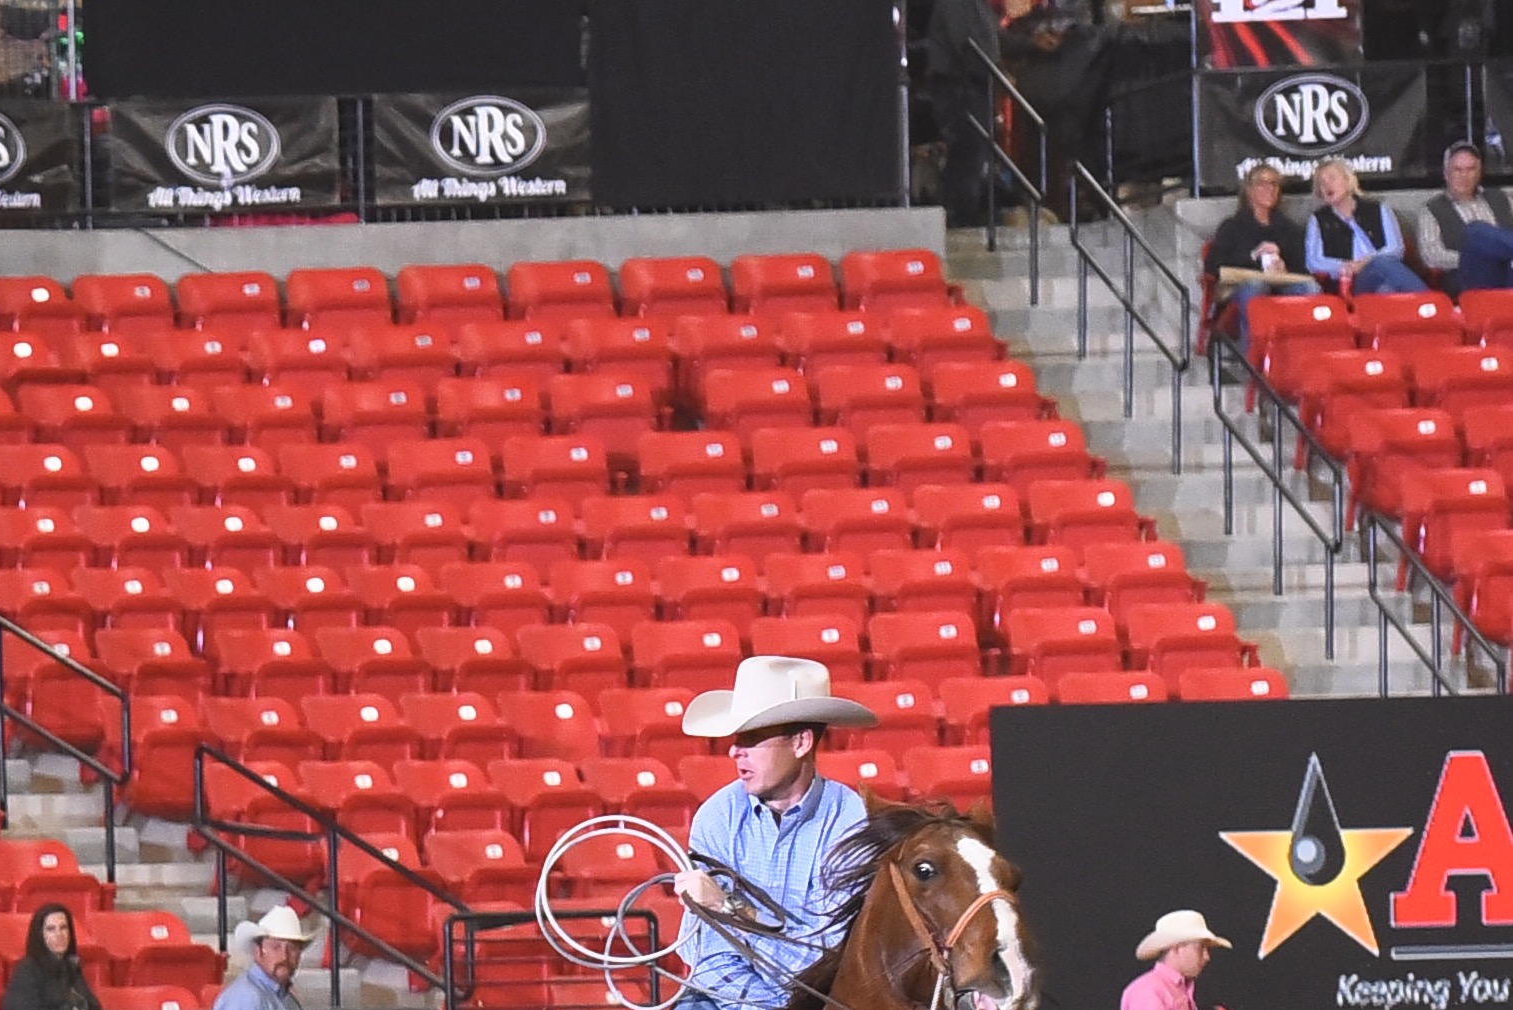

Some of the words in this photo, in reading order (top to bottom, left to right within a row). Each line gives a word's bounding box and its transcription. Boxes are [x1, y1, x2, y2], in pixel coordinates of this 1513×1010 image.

[449, 105, 526, 165] NRS
[1275, 83, 1350, 144] NRS
[185, 114, 261, 174] NRS
